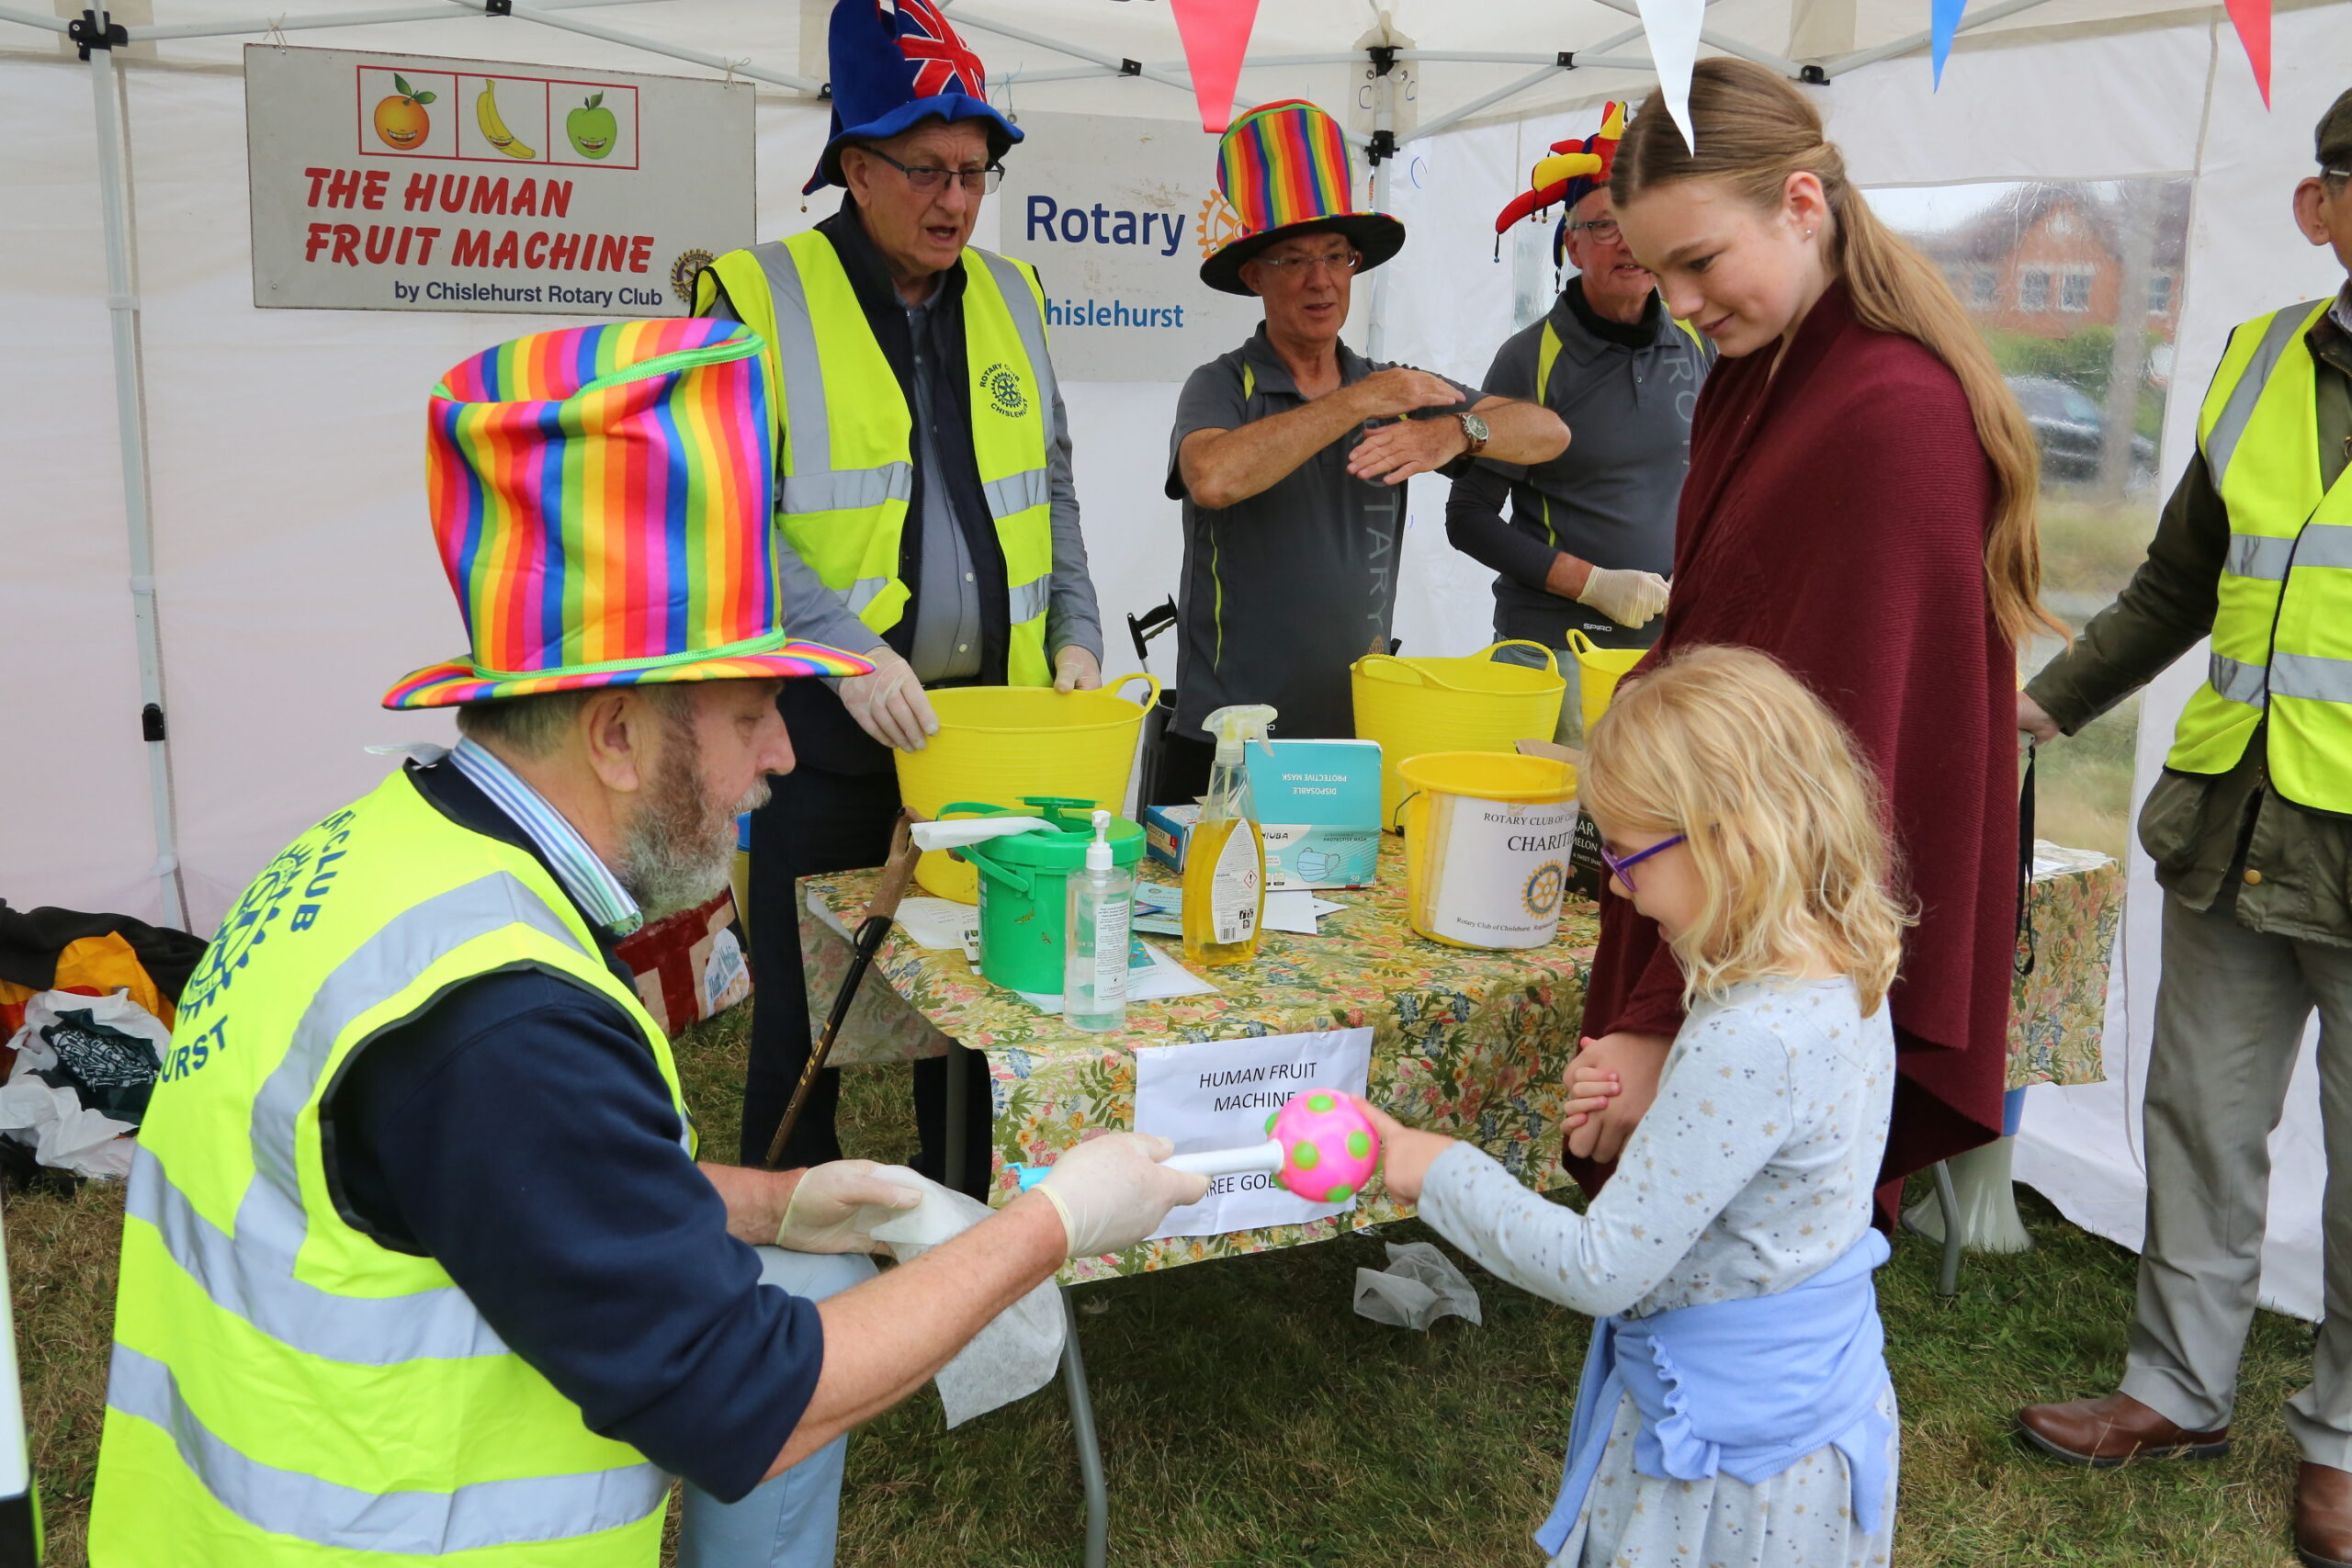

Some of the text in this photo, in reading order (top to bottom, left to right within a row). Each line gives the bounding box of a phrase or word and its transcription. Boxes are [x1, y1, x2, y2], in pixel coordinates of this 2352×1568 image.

[304, 167, 573, 218] THE HUMAN
[1026, 195, 1185, 256] Rotary
[305, 222, 655, 274] FRUIT MACHINE
[394, 281, 420, 303] by
[426, 282, 542, 302] Chislehurst
[548, 285, 614, 309] Rotary
[618, 288, 663, 306] Club
[1046, 299, 1183, 328] hislehurst
[979, 363, 1003, 388] ROTARY
[1583, 623, 1612, 632] SPIRO
[1293, 786, 1337, 795] DISPOSABLE
[1304, 773, 1347, 782] PROTECTIVE
[1484, 812, 1528, 826] ROTARY
[1530, 817, 1554, 826] CLUB
[1508, 827, 1576, 852] CHARITIE
[290, 829, 351, 932] CLUB
[1456, 917, 1476, 928] Rotary
[1477, 921, 1492, 930] Club
[161, 1014, 229, 1084] URST
[1199, 1062, 1317, 1089] HUMAN FRUIT
[1205, 1174, 1277, 1198] REE GOE
